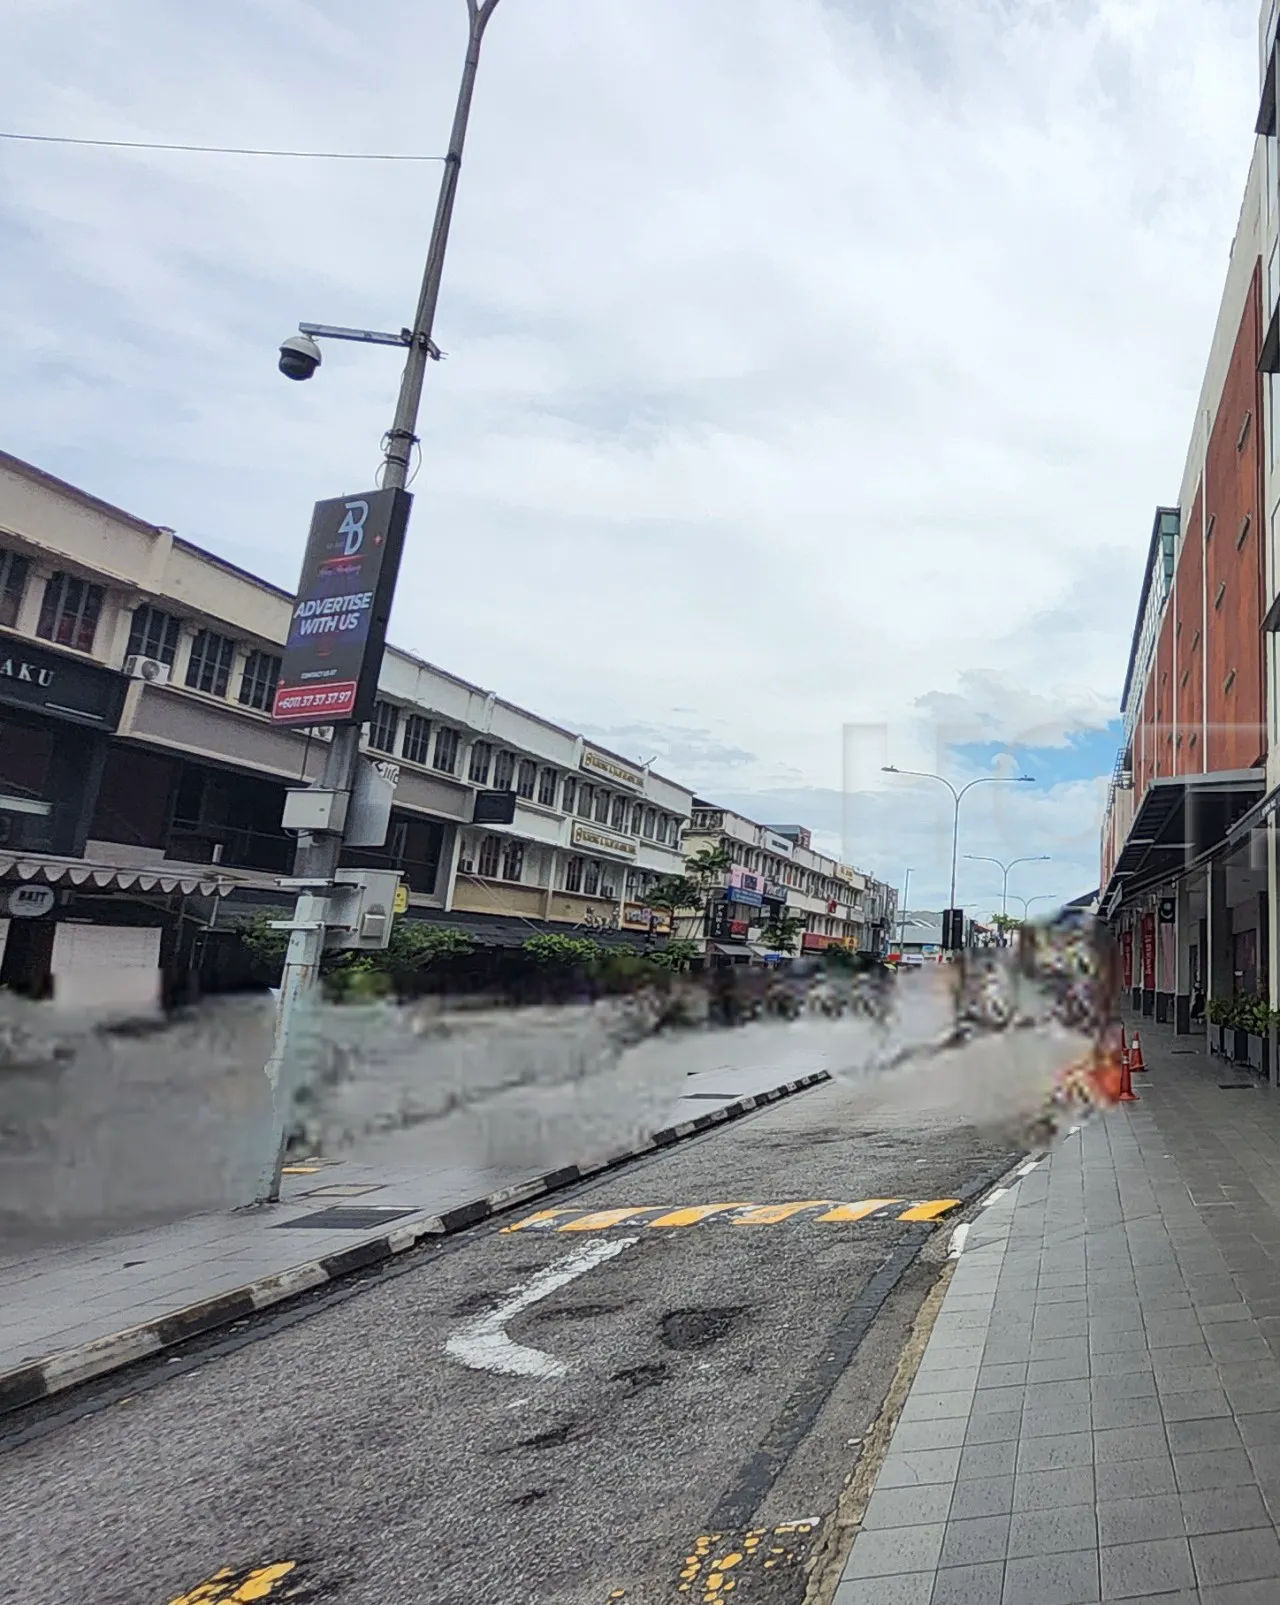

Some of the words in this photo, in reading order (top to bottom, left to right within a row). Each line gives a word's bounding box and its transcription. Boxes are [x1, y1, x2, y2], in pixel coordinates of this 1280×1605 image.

[294, 592, 373, 618] ADVERTISE
[300, 614, 341, 636] WITH
[340, 612, 361, 631] US
